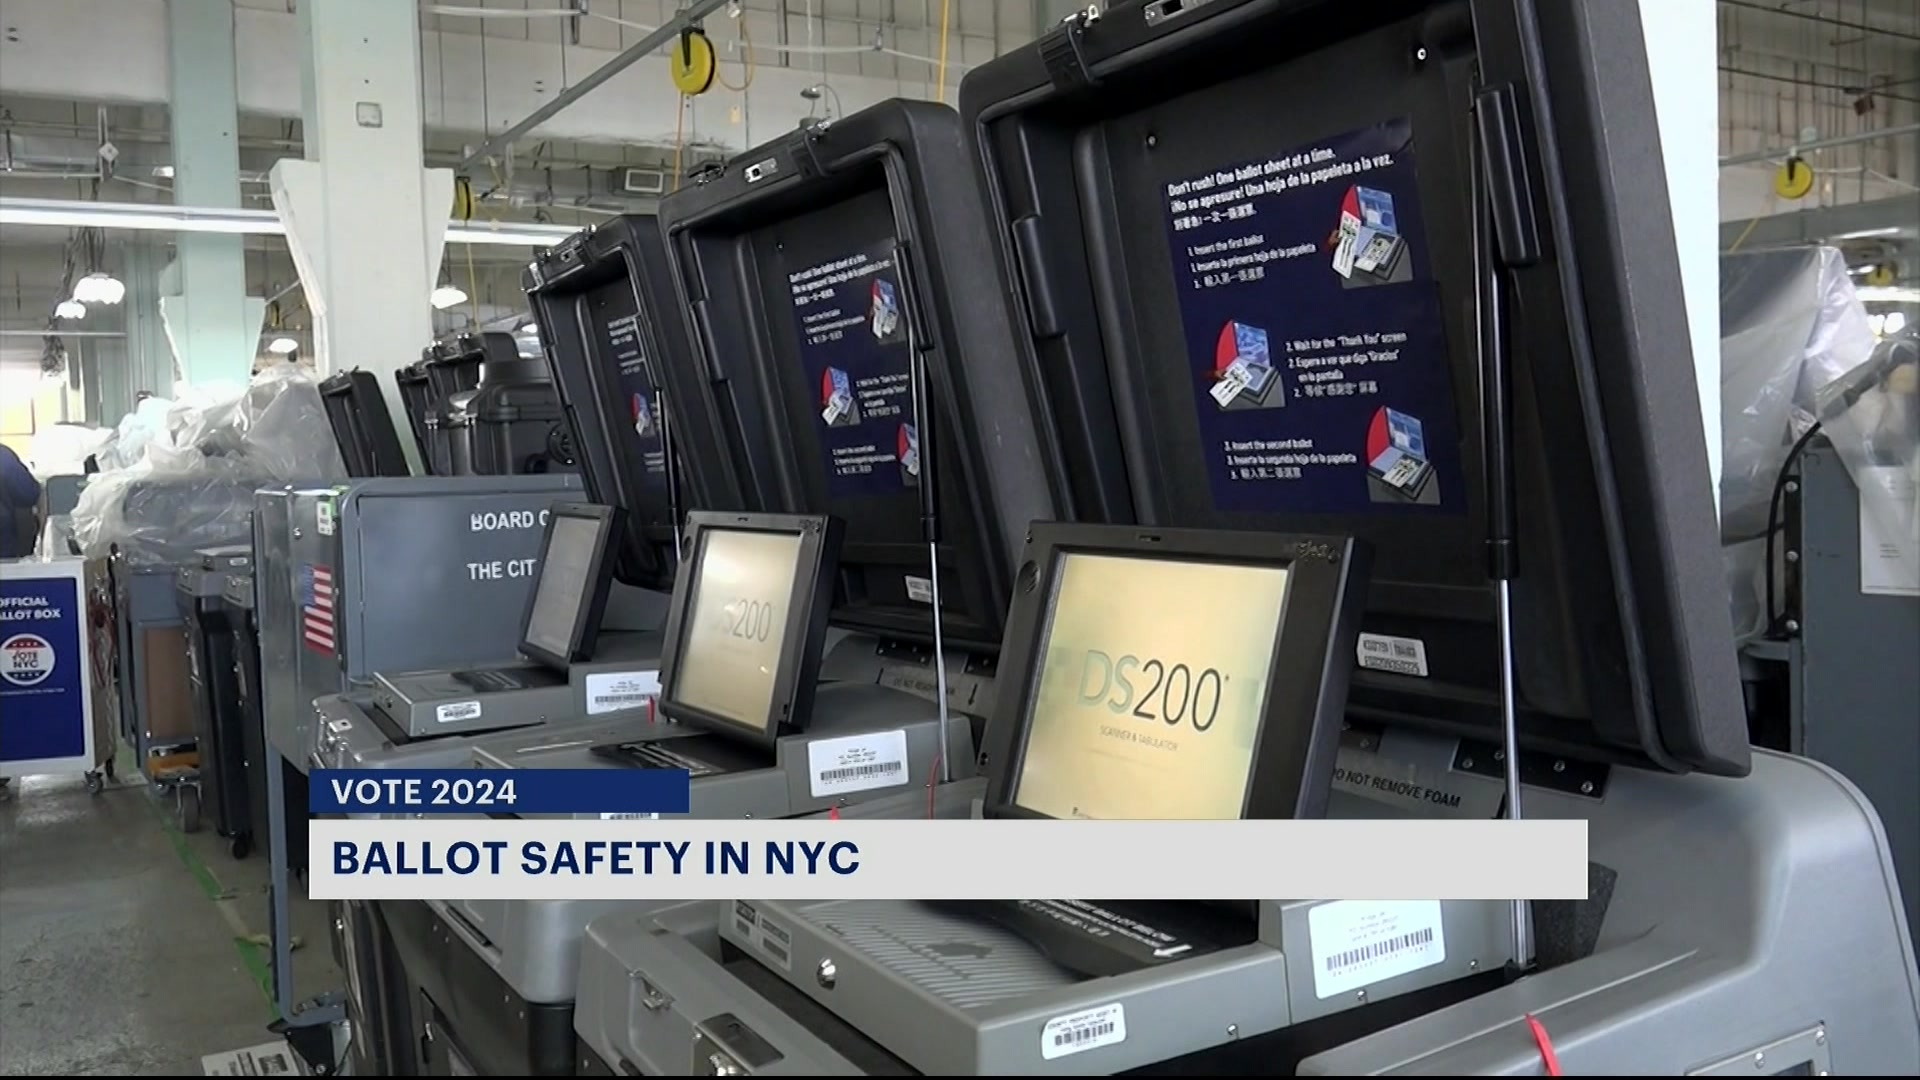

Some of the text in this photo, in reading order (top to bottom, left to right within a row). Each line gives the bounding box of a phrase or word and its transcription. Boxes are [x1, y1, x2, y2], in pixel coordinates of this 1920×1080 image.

[1168, 148, 1336, 196] Don't rush! One ballot sheet at a time.
[1188, 199, 1199, 210] se
[1200, 186, 1245, 208] apresure!
[1245, 184, 1264, 196] Una
[1264, 176, 1286, 194] hoja
[1287, 174, 1299, 188] de
[1300, 171, 1310, 185] la
[1311, 162, 1353, 185] papeleta
[1354, 161, 1360, 173] a
[1360, 156, 1372, 171] la
[1372, 153, 1394, 168] vez.
[1215, 242, 1227, 251] the
[1228, 238, 1243, 249] first
[1323, 339, 1336, 349] the
[471, 509, 550, 531] BOARD O
[466, 559, 537, 580] THE CIT
[0, 608, 61, 620] LLOT BOX
[12, 651, 38, 660] VOTE
[13, 660, 38, 668] NYC
[1100, 725, 1131, 740] SCANNER
[1138, 734, 1178, 751] TABULATOR
[1346, 771, 1369, 785] NOT
[1371, 776, 1422, 799] REMOVE
[1423, 789, 1461, 808] FOAM
